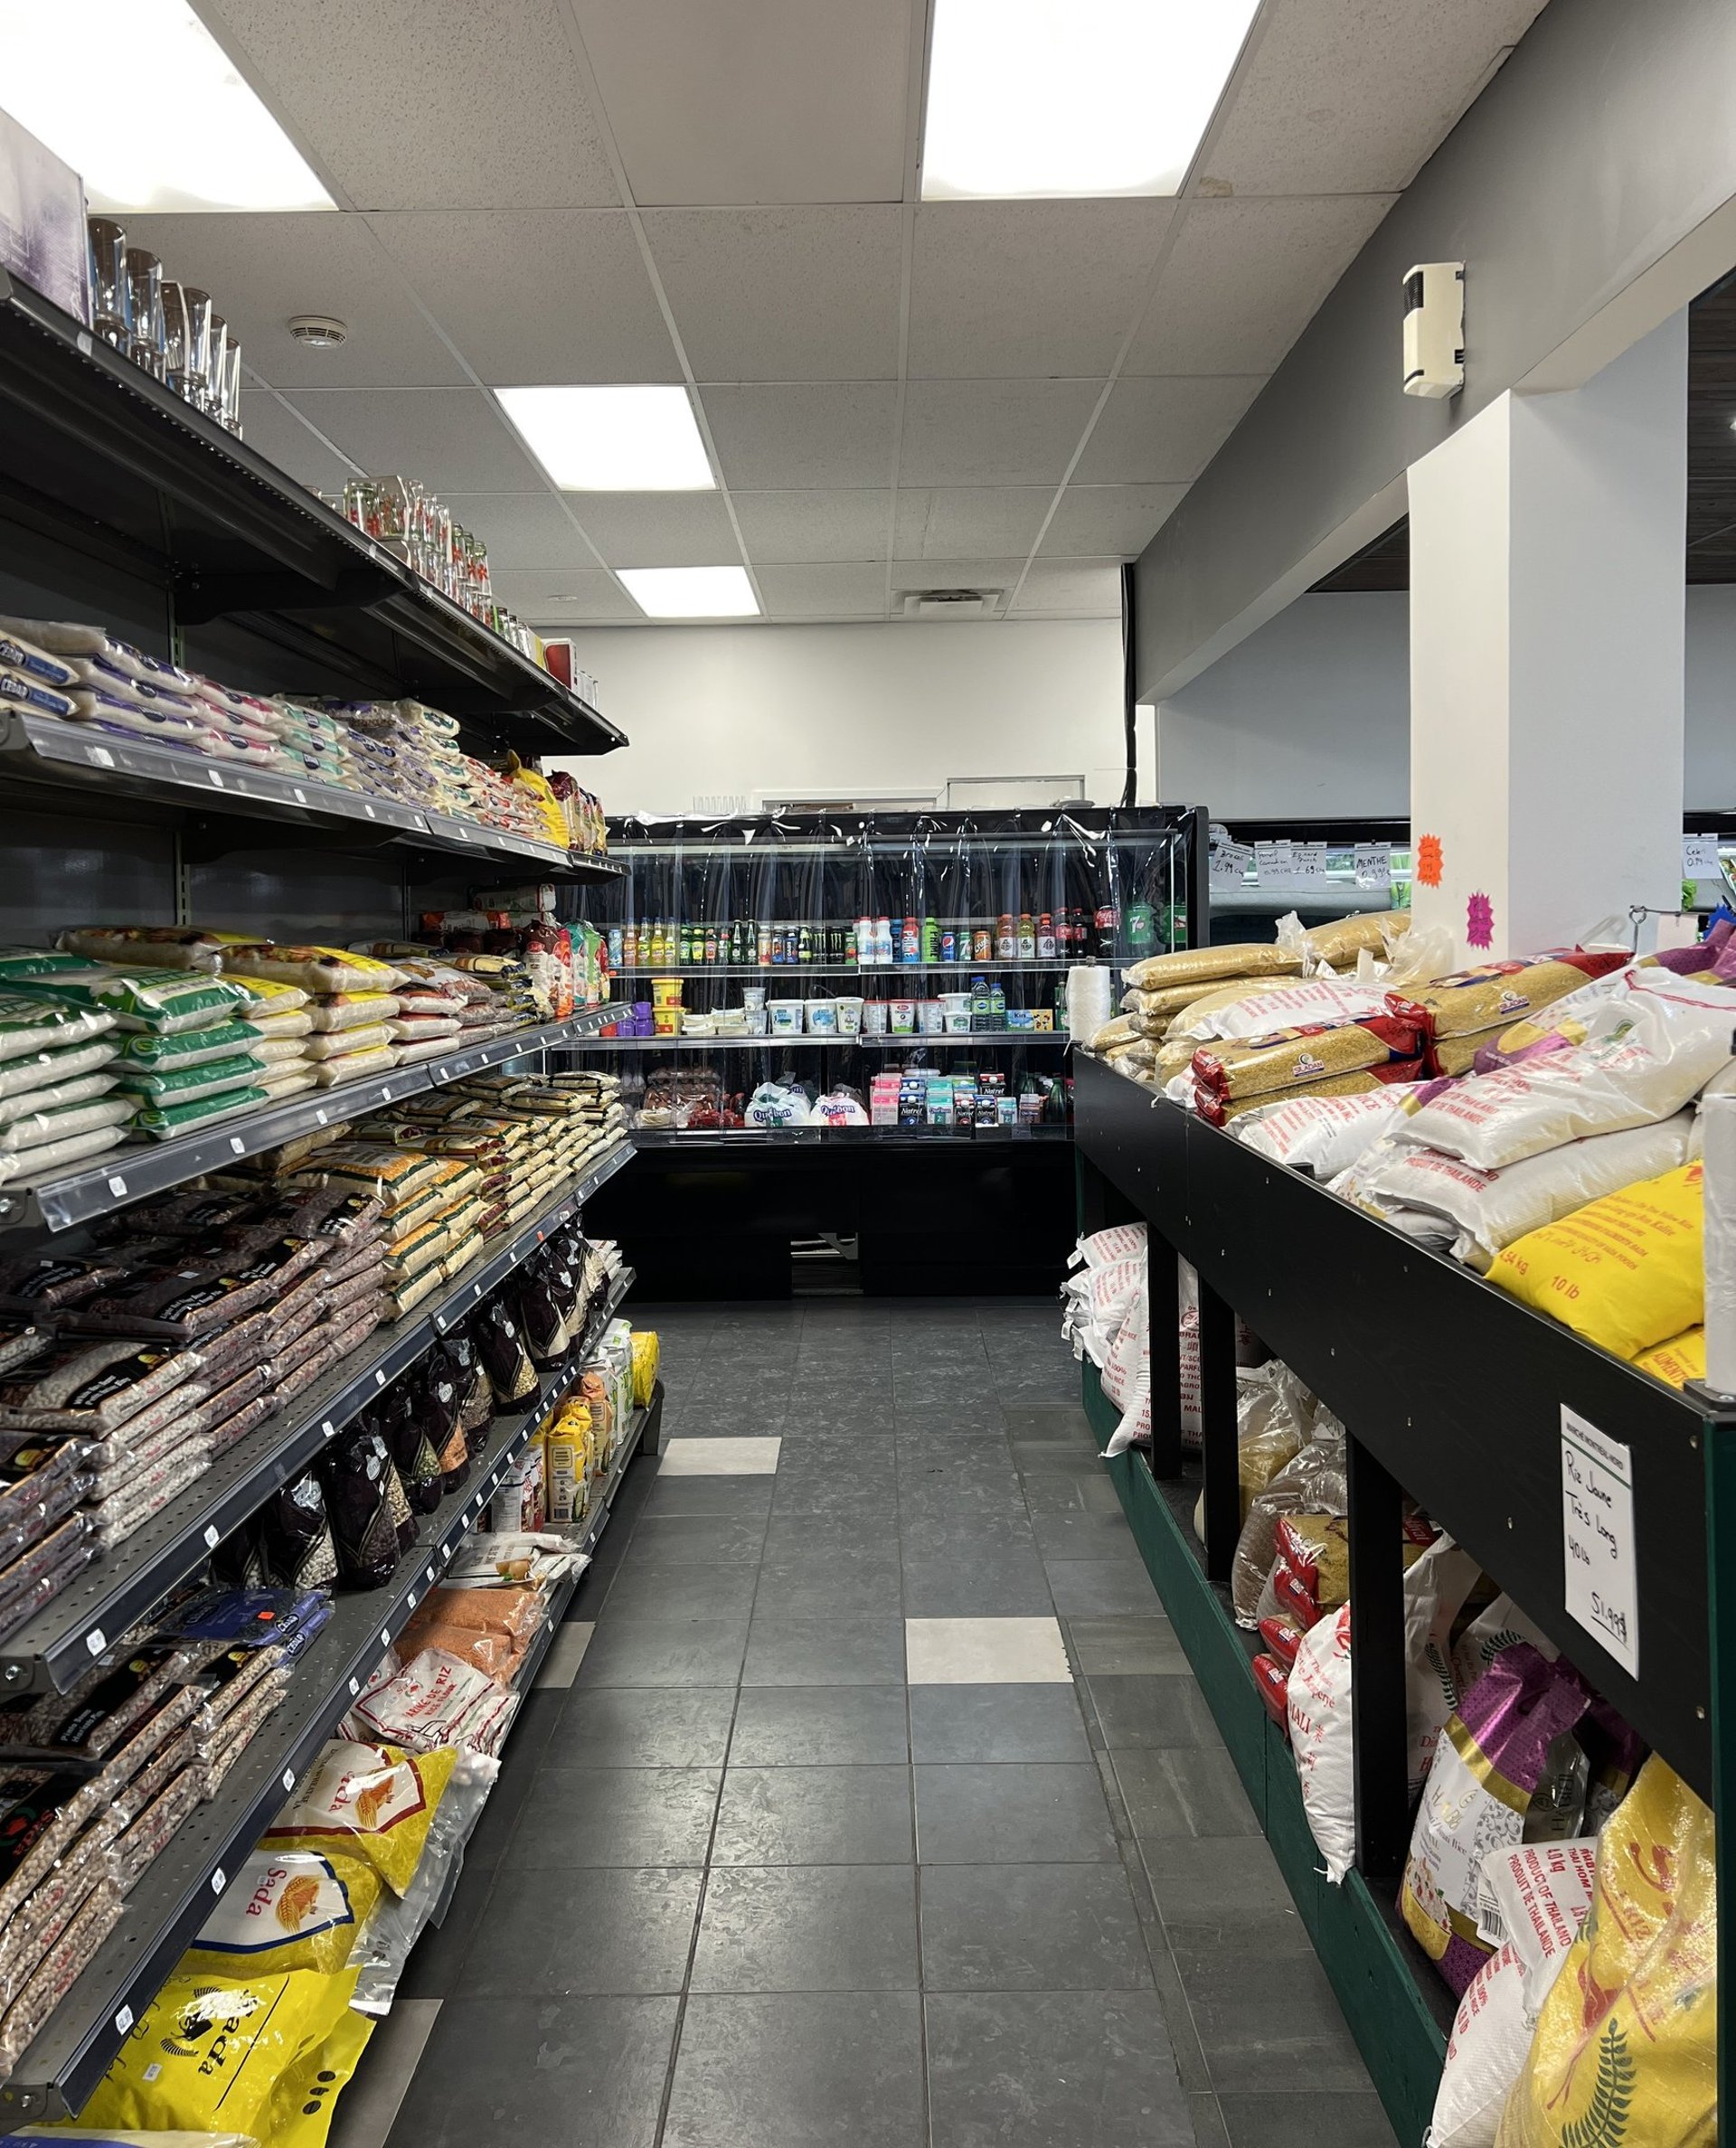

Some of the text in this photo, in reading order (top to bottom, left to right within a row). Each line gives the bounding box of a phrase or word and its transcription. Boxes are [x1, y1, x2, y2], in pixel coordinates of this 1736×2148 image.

[1356, 856, 1387, 869] MENTHE
[1442, 1164, 1487, 1193] THAILANDE
[1551, 1275, 1580, 1300] 10 lb
[1565, 1449, 1582, 1484] Riz
[1596, 1514, 1618, 1560] Long
[436, 1665, 452, 1687] RIZ
[245, 1867, 288, 1917] Sada
[1576, 1865, 1592, 1889] HOM
[1507, 1853, 1556, 1959] PRODUIT DE THAILANDE
[1524, 1848, 1572, 1947] PRODUCT OF THAILAND
